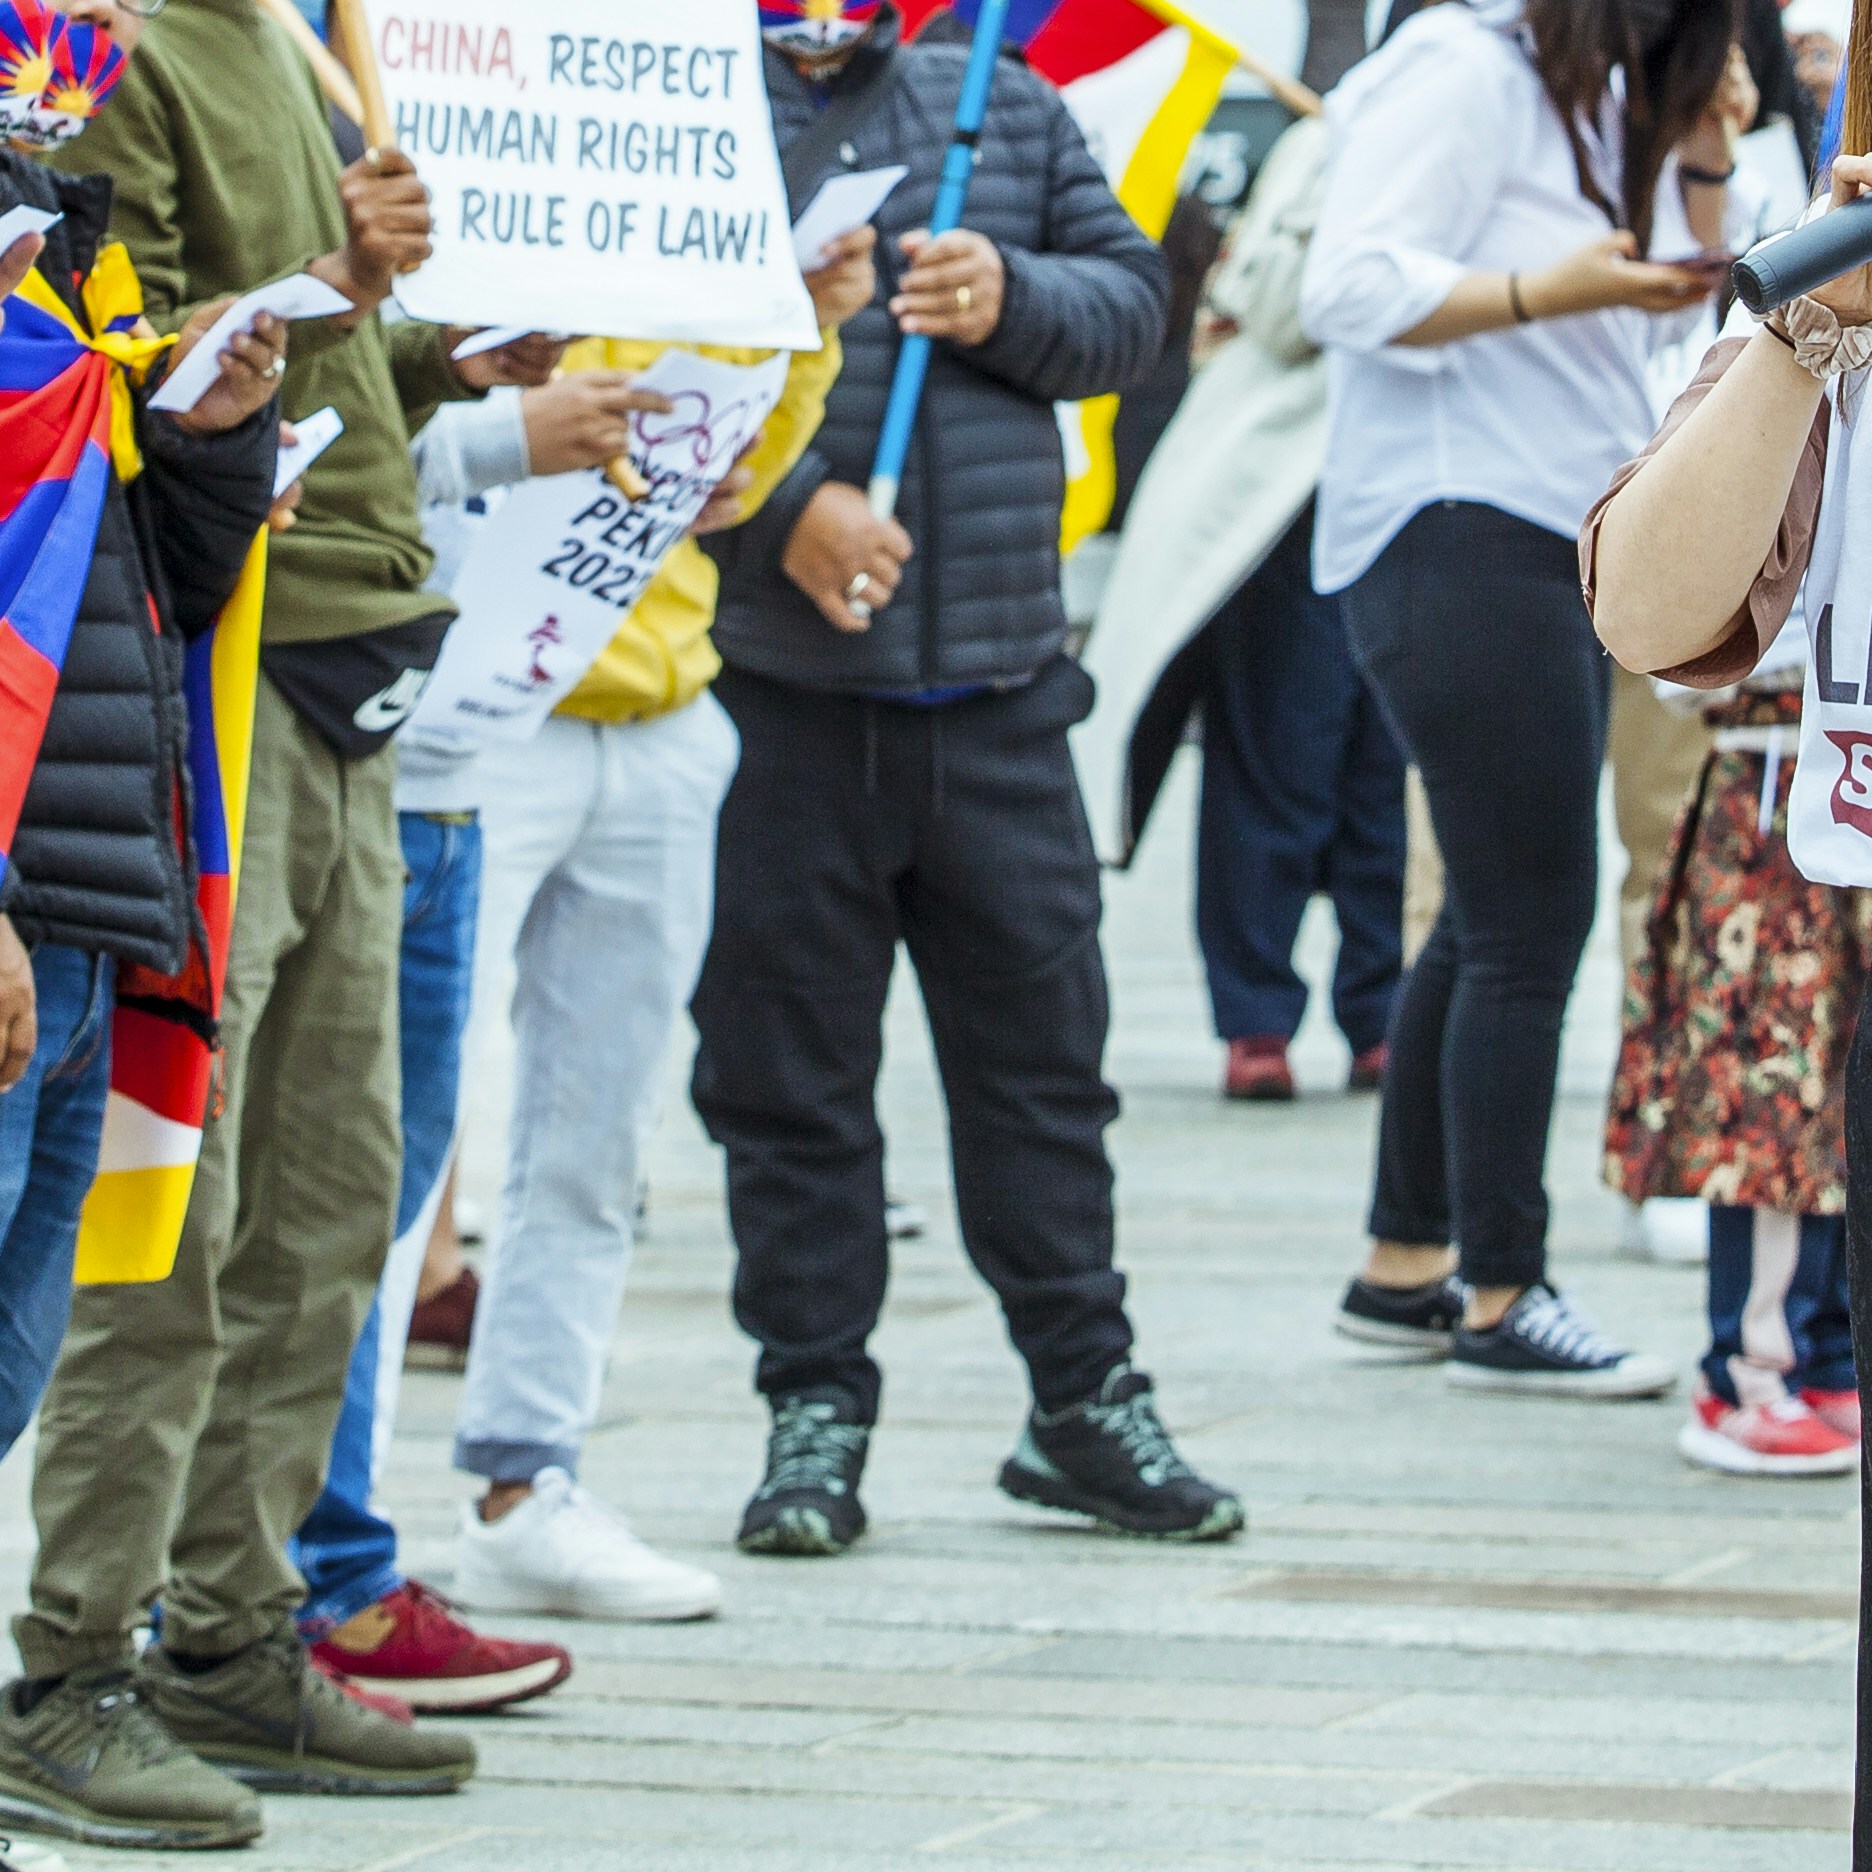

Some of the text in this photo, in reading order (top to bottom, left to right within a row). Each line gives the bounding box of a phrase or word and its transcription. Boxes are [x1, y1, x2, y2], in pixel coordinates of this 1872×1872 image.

[378, 16, 740, 99] CHINA, RESPECT
[395, 100, 738, 181] HUMAN RIGHTS
[459, 188, 770, 265] RULE OF LAW!
